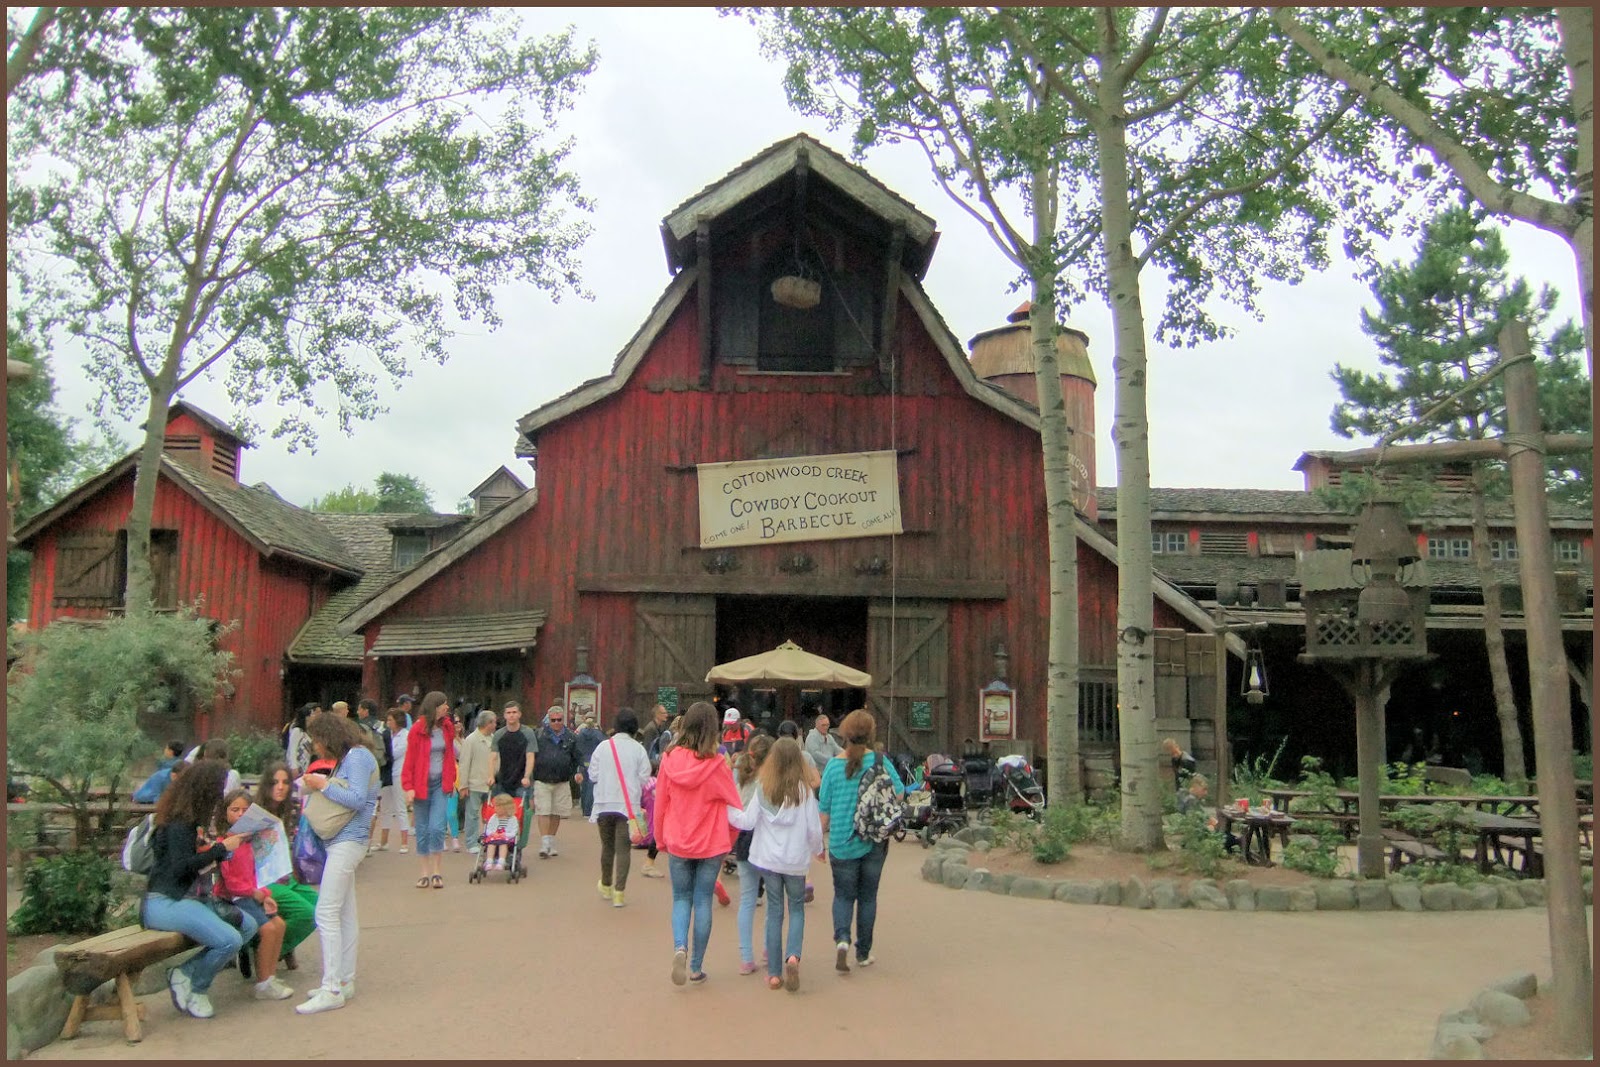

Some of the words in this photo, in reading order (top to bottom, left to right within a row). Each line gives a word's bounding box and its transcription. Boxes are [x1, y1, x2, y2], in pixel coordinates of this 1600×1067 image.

[722, 465, 822, 495] COTTONWOOD
[826, 467, 868, 484] CREEK
[730, 496, 800, 518] COWBOY
[804, 490, 877, 510] COOKOUT
[760, 512, 856, 539] BARBECUE
[861, 515, 883, 530] COME
[703, 529, 728, 545] COME
